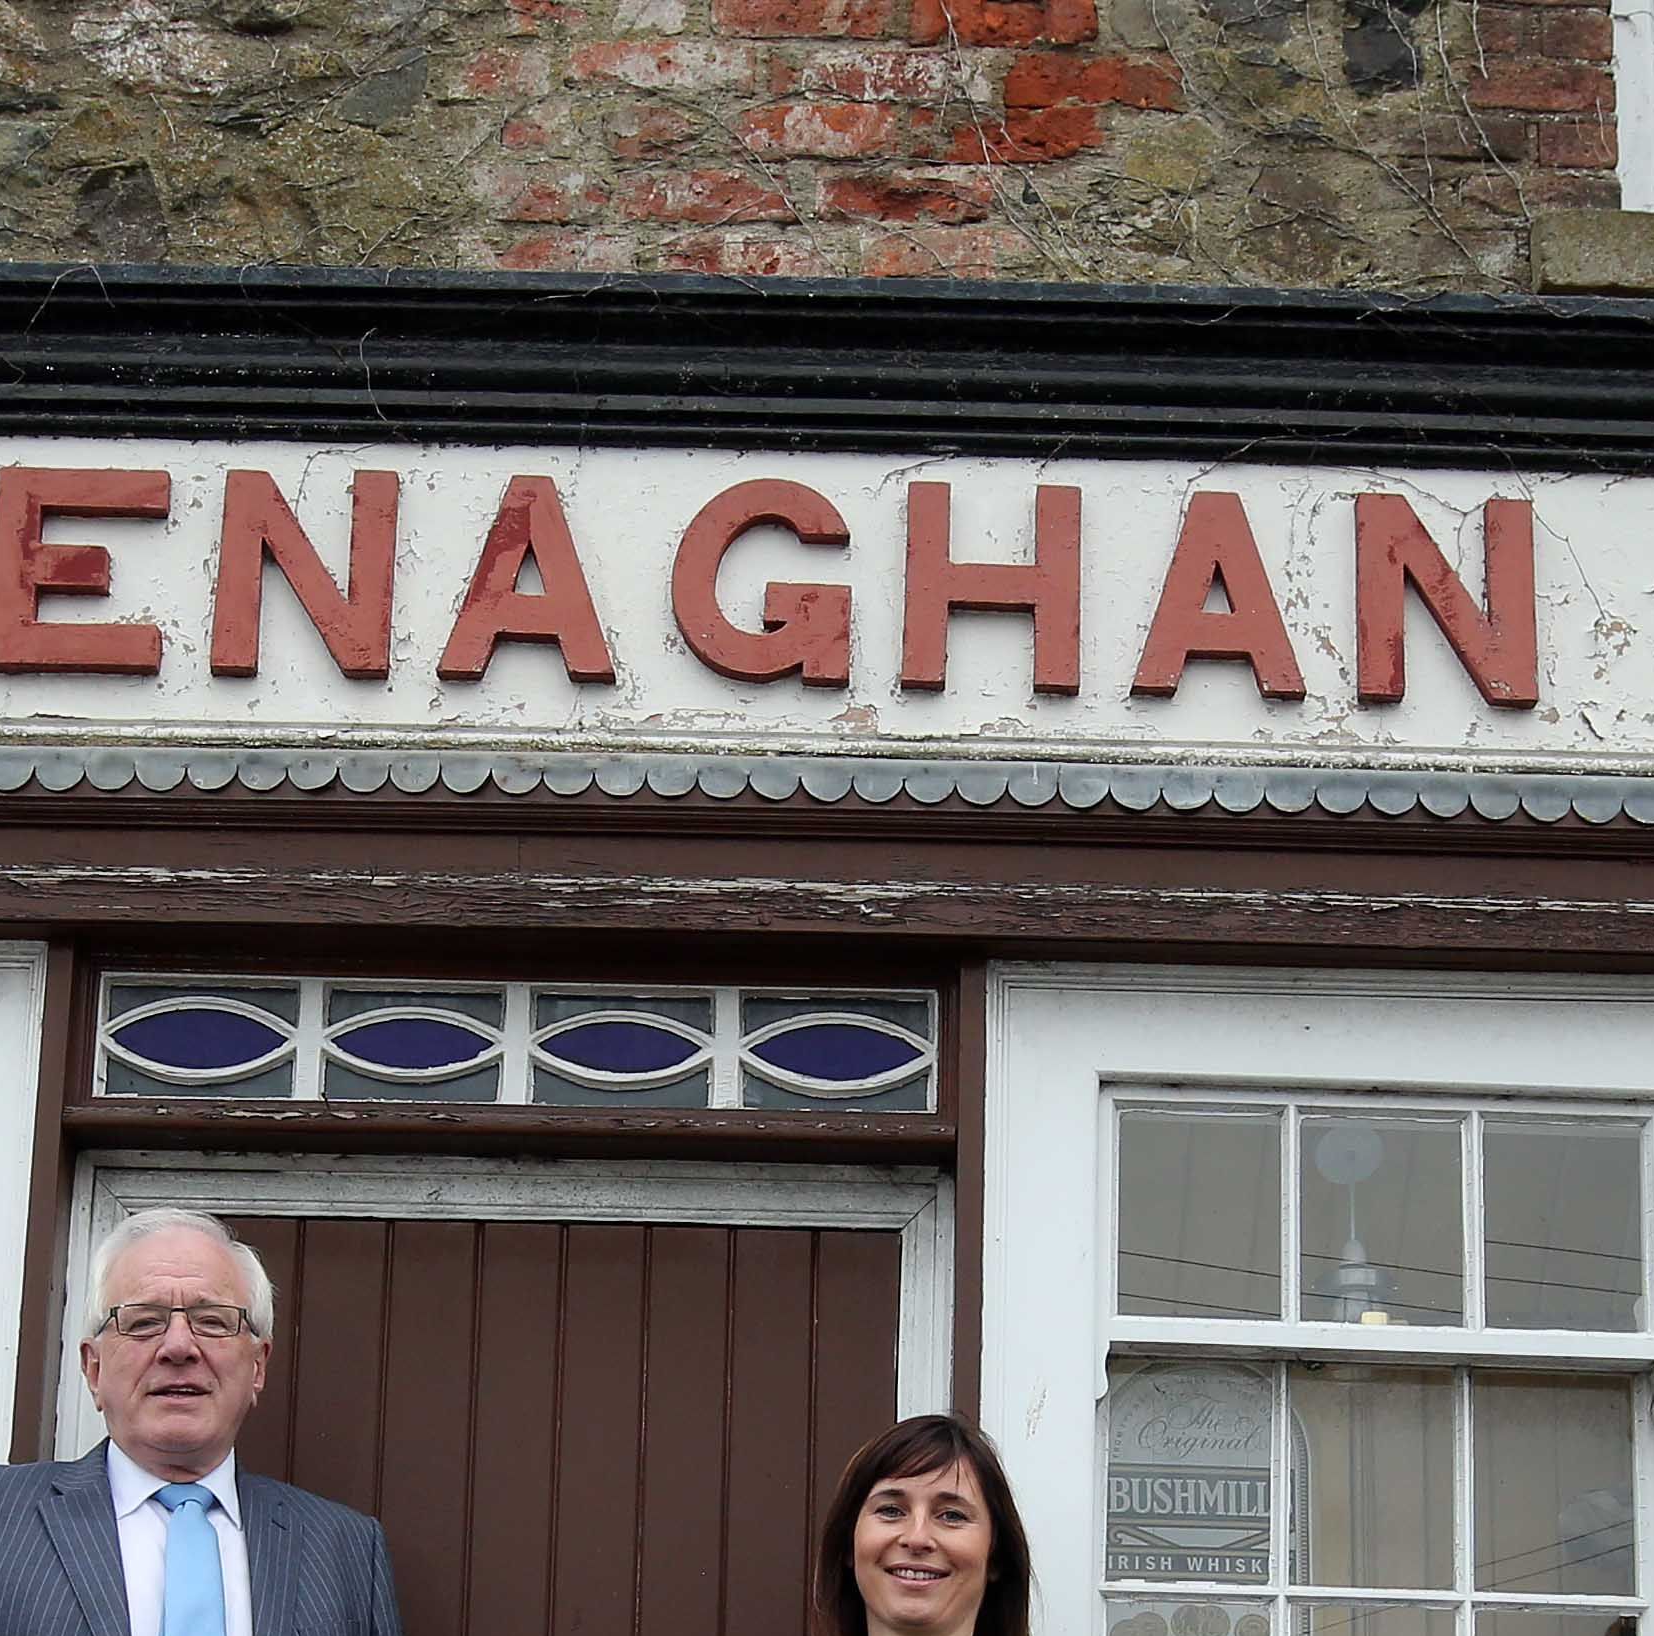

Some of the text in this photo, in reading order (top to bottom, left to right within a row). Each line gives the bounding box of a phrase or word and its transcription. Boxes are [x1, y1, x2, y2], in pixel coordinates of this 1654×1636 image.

[1139, 1415, 1264, 1458] Original
[1108, 1476, 1269, 1517] BUSHMILL
[1108, 1555, 1294, 1574] IRISH WHISK
